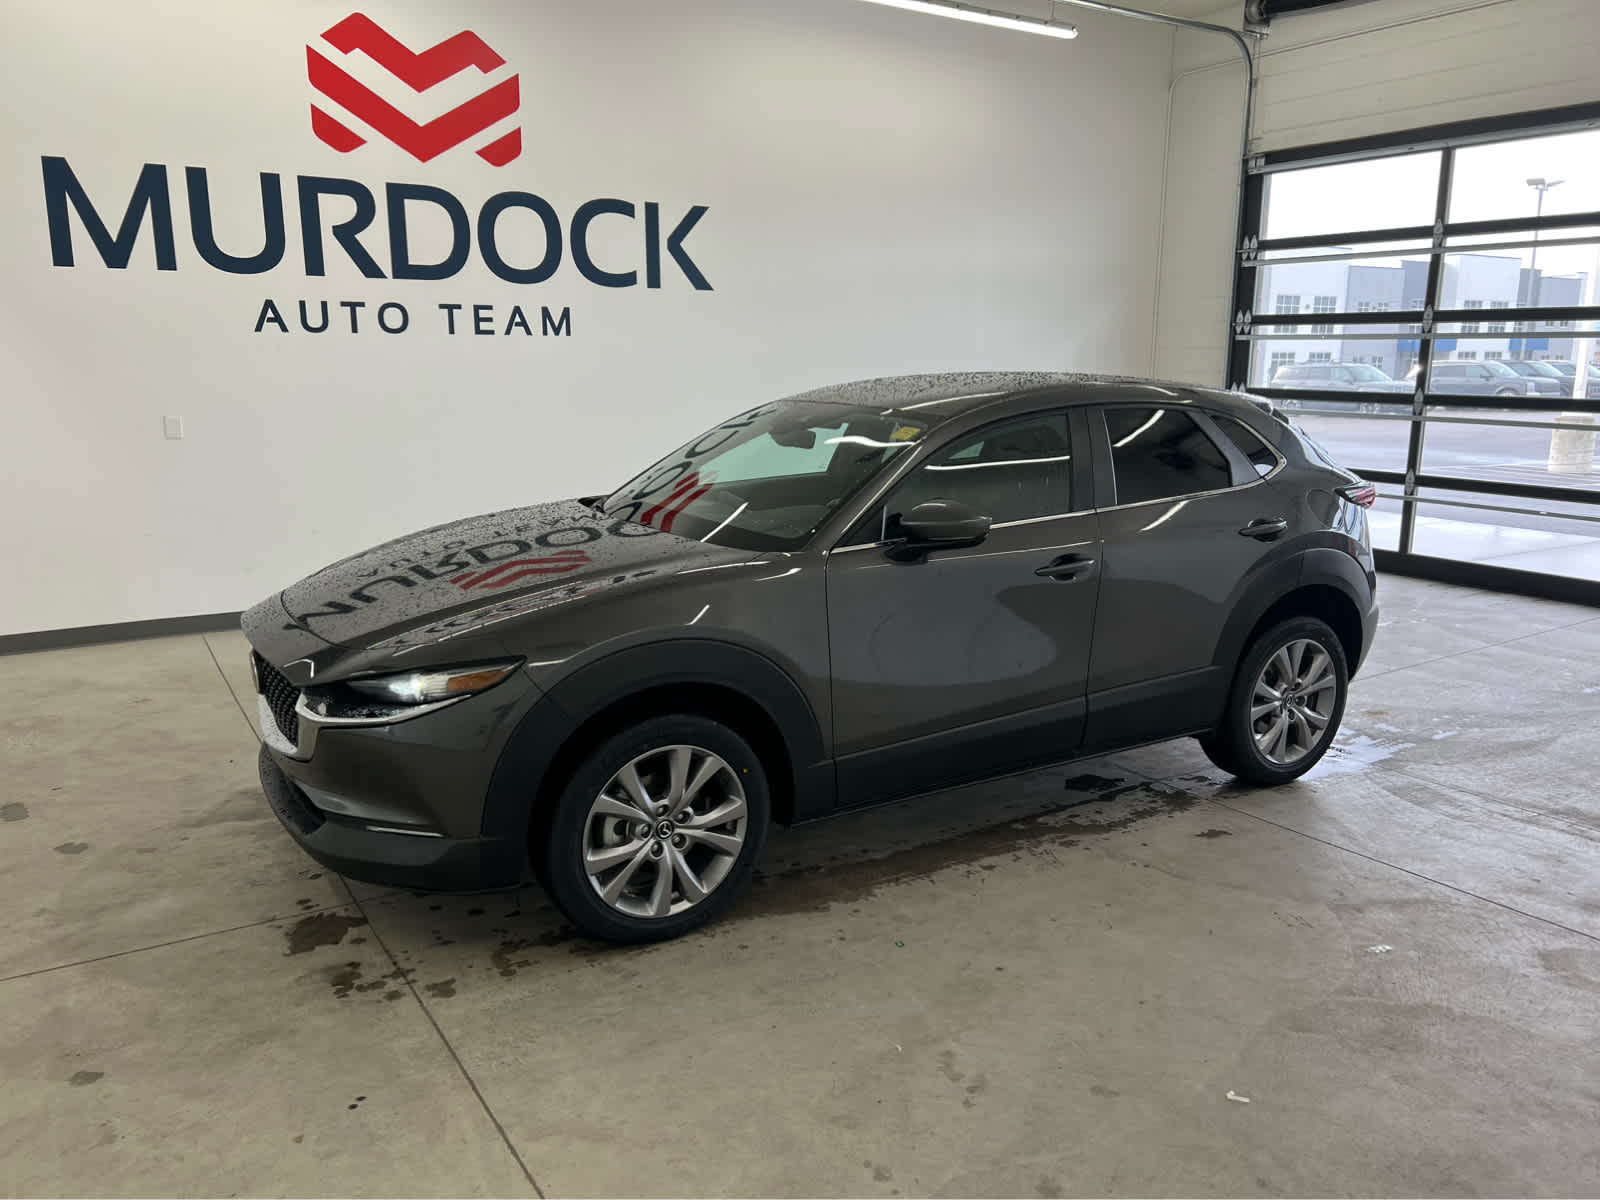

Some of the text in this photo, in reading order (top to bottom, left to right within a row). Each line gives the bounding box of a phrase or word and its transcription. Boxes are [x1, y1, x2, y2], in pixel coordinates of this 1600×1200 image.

[41, 156, 713, 291] MURDOCK
[255, 299, 570, 336] AUTO TEAM
